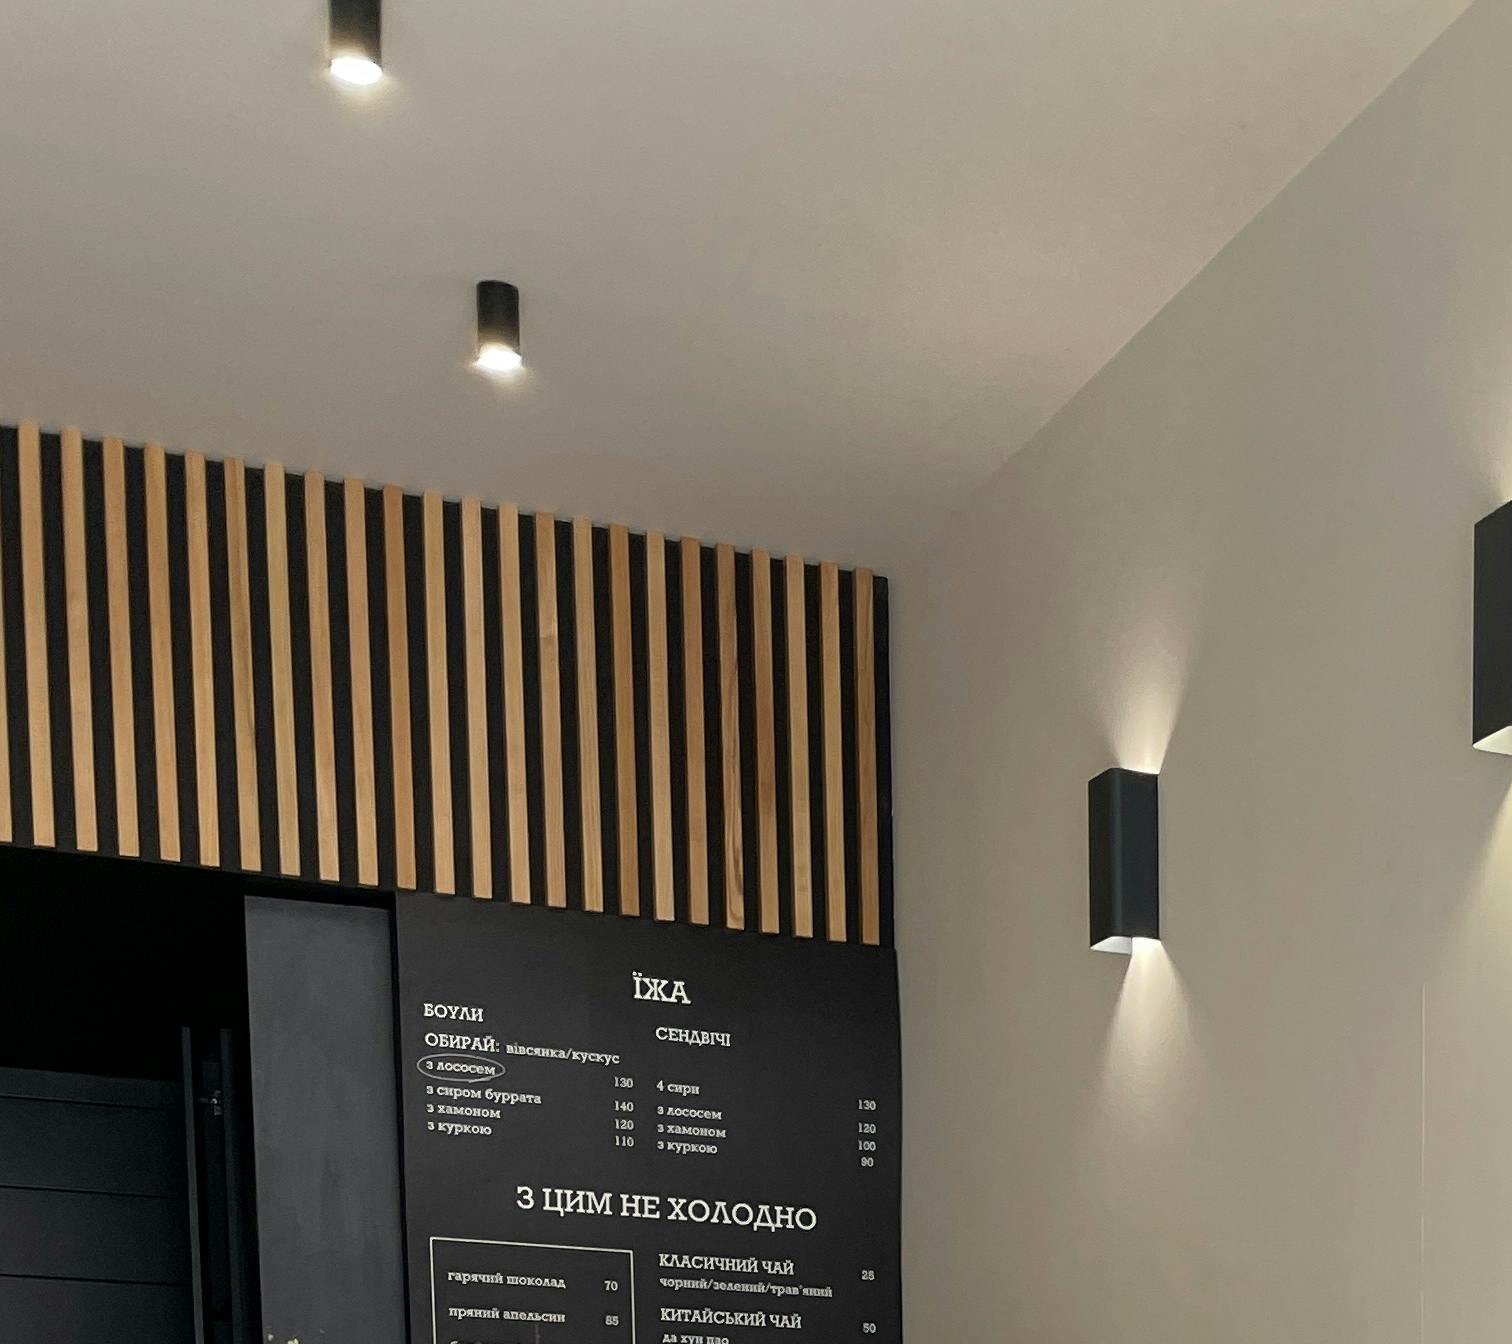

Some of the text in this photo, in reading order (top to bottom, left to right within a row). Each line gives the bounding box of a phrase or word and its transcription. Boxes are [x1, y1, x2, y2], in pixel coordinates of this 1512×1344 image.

[633, 972, 691, 1004] ЇЖА
[424, 1003, 483, 1022] БОУЛИ
[425, 1033, 619, 1065] ОБИРАЙ: вівсянка/кускус
[656, 1027, 730, 1046] СЕНДВІЧІ
[426, 1061, 633, 1087] з лососем 130
[427, 1086, 633, 1111] з сиром буррата 140
[657, 1080, 876, 1110] 4 сири 130
[427, 1104, 633, 1130] з хамоном 120
[658, 1106, 876, 1133] з лососем 120
[428, 1122, 634, 1146] з куркою 110
[658, 1124, 876, 1151] з хамоном 100
[658, 1141, 873, 1167] з куркою 90
[517, 1186, 816, 1232] З ЦИМ НЕ ХОЛОДНО
[659, 1254, 874, 1280] КЛАСИЧНИЙ ЧАЙ 25
[448, 1272, 618, 1290] гарячий шоколад 70
[449, 1308, 619, 1325] пряний апельсин 85
[661, 1308, 876, 1333] КИТАЙСЬКИЙ ЧАЙ 50
[663, 1334, 677, 1343] да
[707, 1336, 729, 1344] пао
